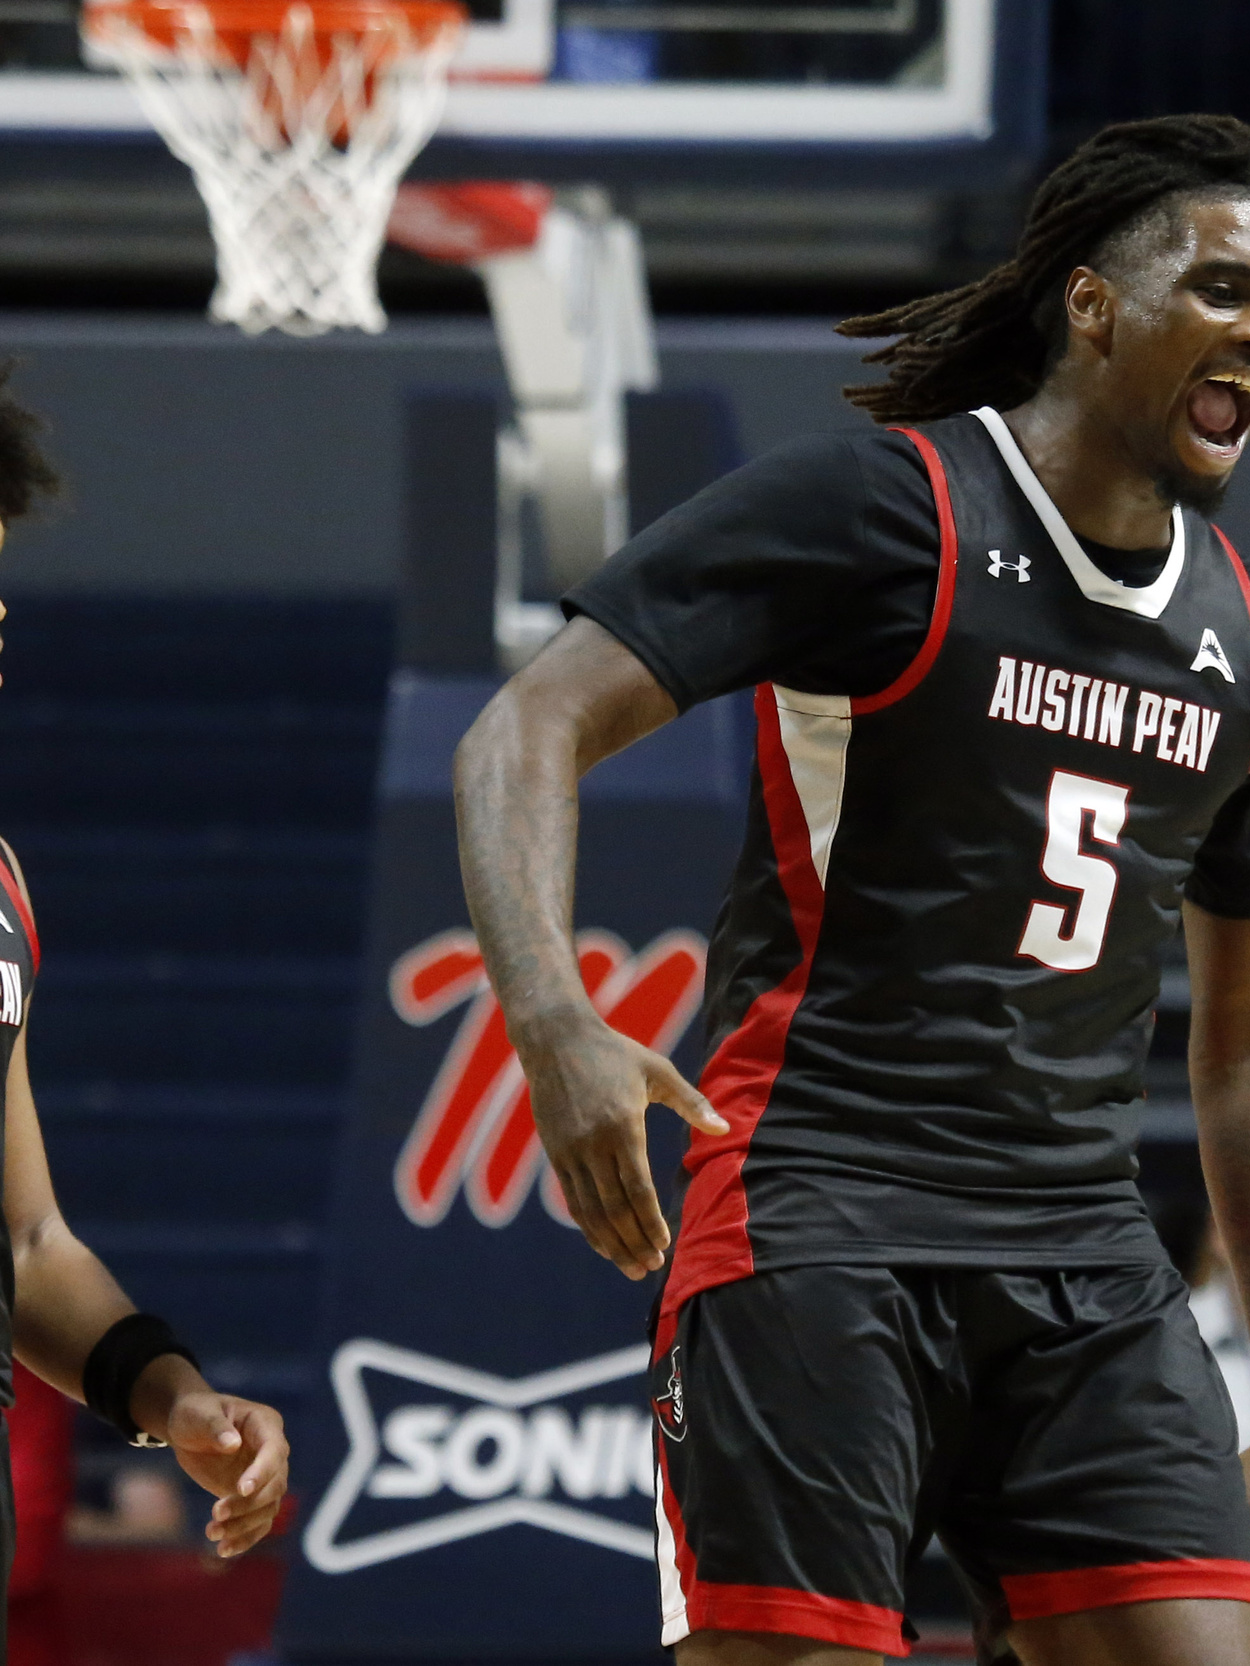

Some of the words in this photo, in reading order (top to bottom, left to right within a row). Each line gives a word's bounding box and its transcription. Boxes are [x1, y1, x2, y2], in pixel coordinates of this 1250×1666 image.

[988, 656, 1130, 748] AUSTIN
[1131, 690, 1221, 773] PEAY
[1015, 767, 1132, 973] 5
[0, 959, 23, 1027] AY
